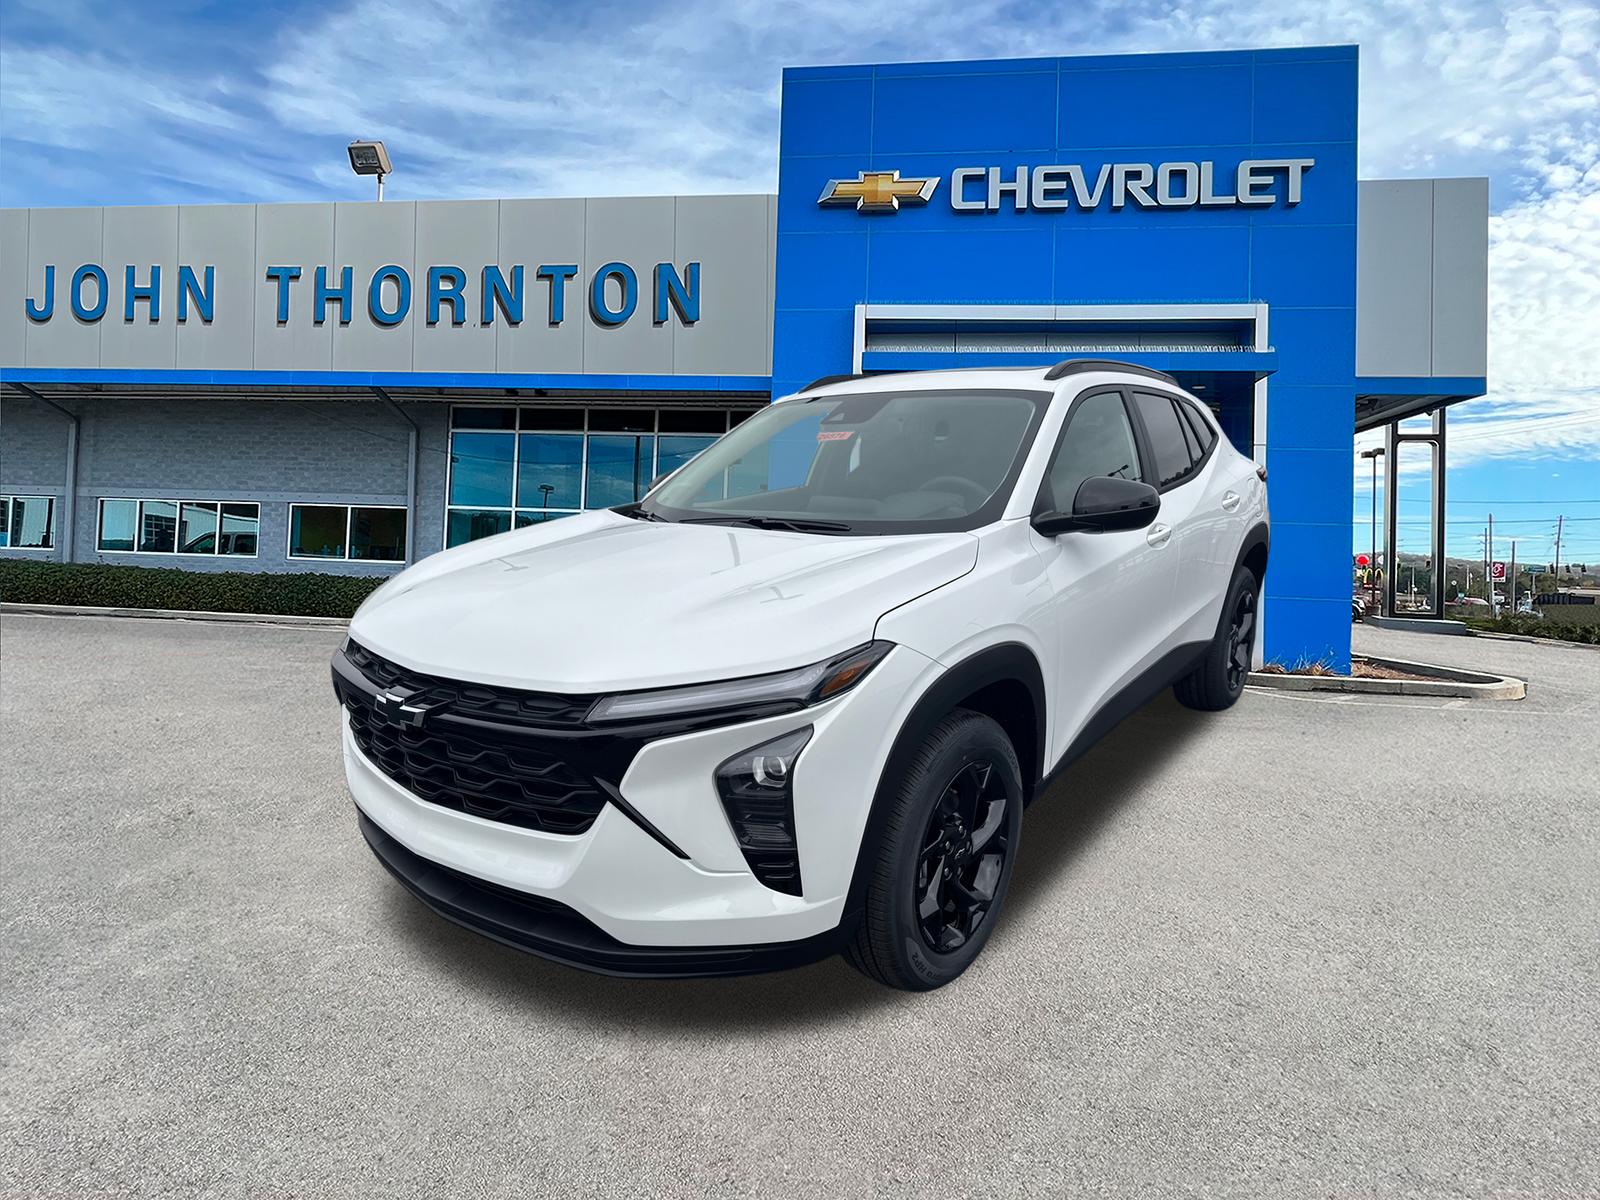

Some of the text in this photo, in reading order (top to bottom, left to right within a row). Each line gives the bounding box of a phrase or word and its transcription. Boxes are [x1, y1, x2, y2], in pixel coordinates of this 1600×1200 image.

[951, 158, 1315, 210] CHEVROLET
[25, 261, 701, 328] JOHN THORNTON
